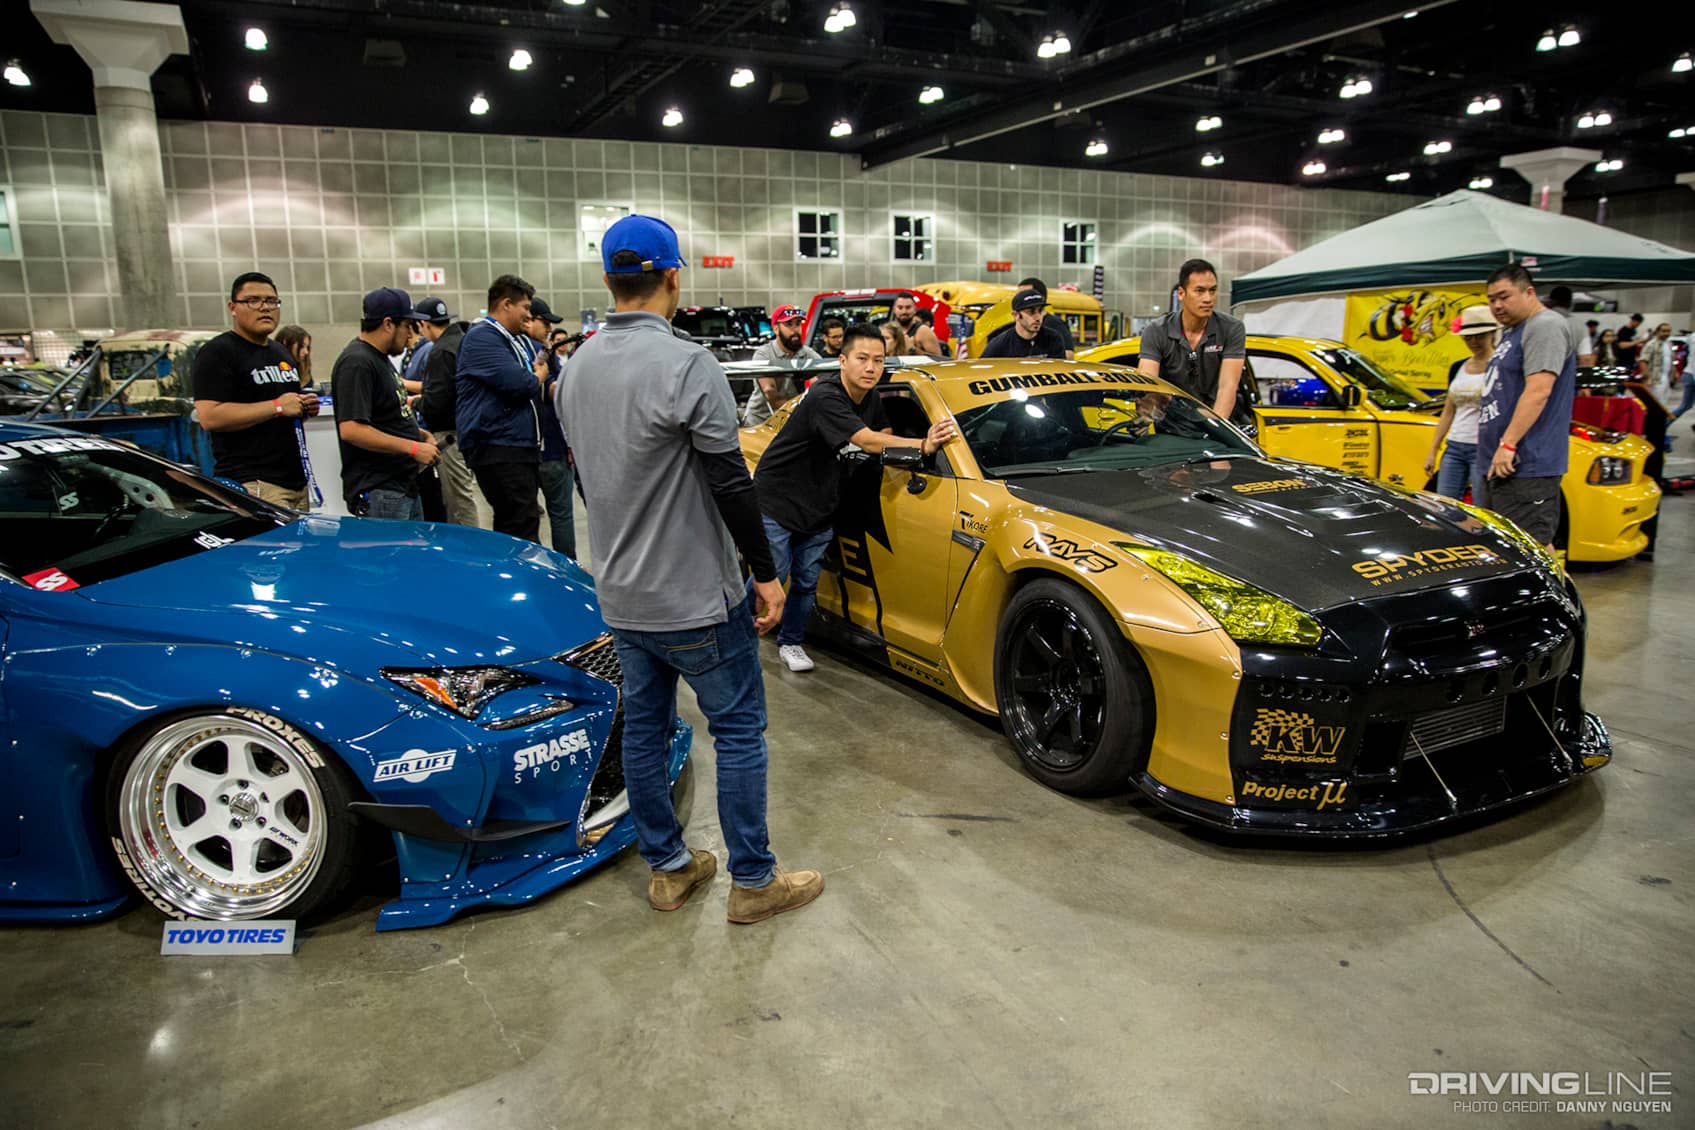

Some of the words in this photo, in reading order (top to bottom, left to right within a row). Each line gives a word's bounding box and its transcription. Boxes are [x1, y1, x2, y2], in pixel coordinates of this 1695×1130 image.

[703, 256, 733, 268] EXIT
[968, 373, 1102, 396] GUMBALL
[1099, 371, 1159, 386] 3000
[1231, 479, 1307, 493] SEBON
[1023, 532, 1118, 573] RAYS
[1351, 544, 1500, 579] SPYDER
[225, 706, 326, 769] PROXES
[513, 728, 591, 772] STRASSE
[1264, 725, 1346, 755] KW
[378, 761, 411, 777] AIR
[415, 753, 451, 770] LIFT
[514, 748, 594, 785] SPORT
[1260, 753, 1337, 764] suspensions
[1241, 781, 1319, 801] Project
[111, 836, 157, 902] TIRES
[167, 929, 225, 944] TOYO
[227, 928, 286, 944] TIRES
